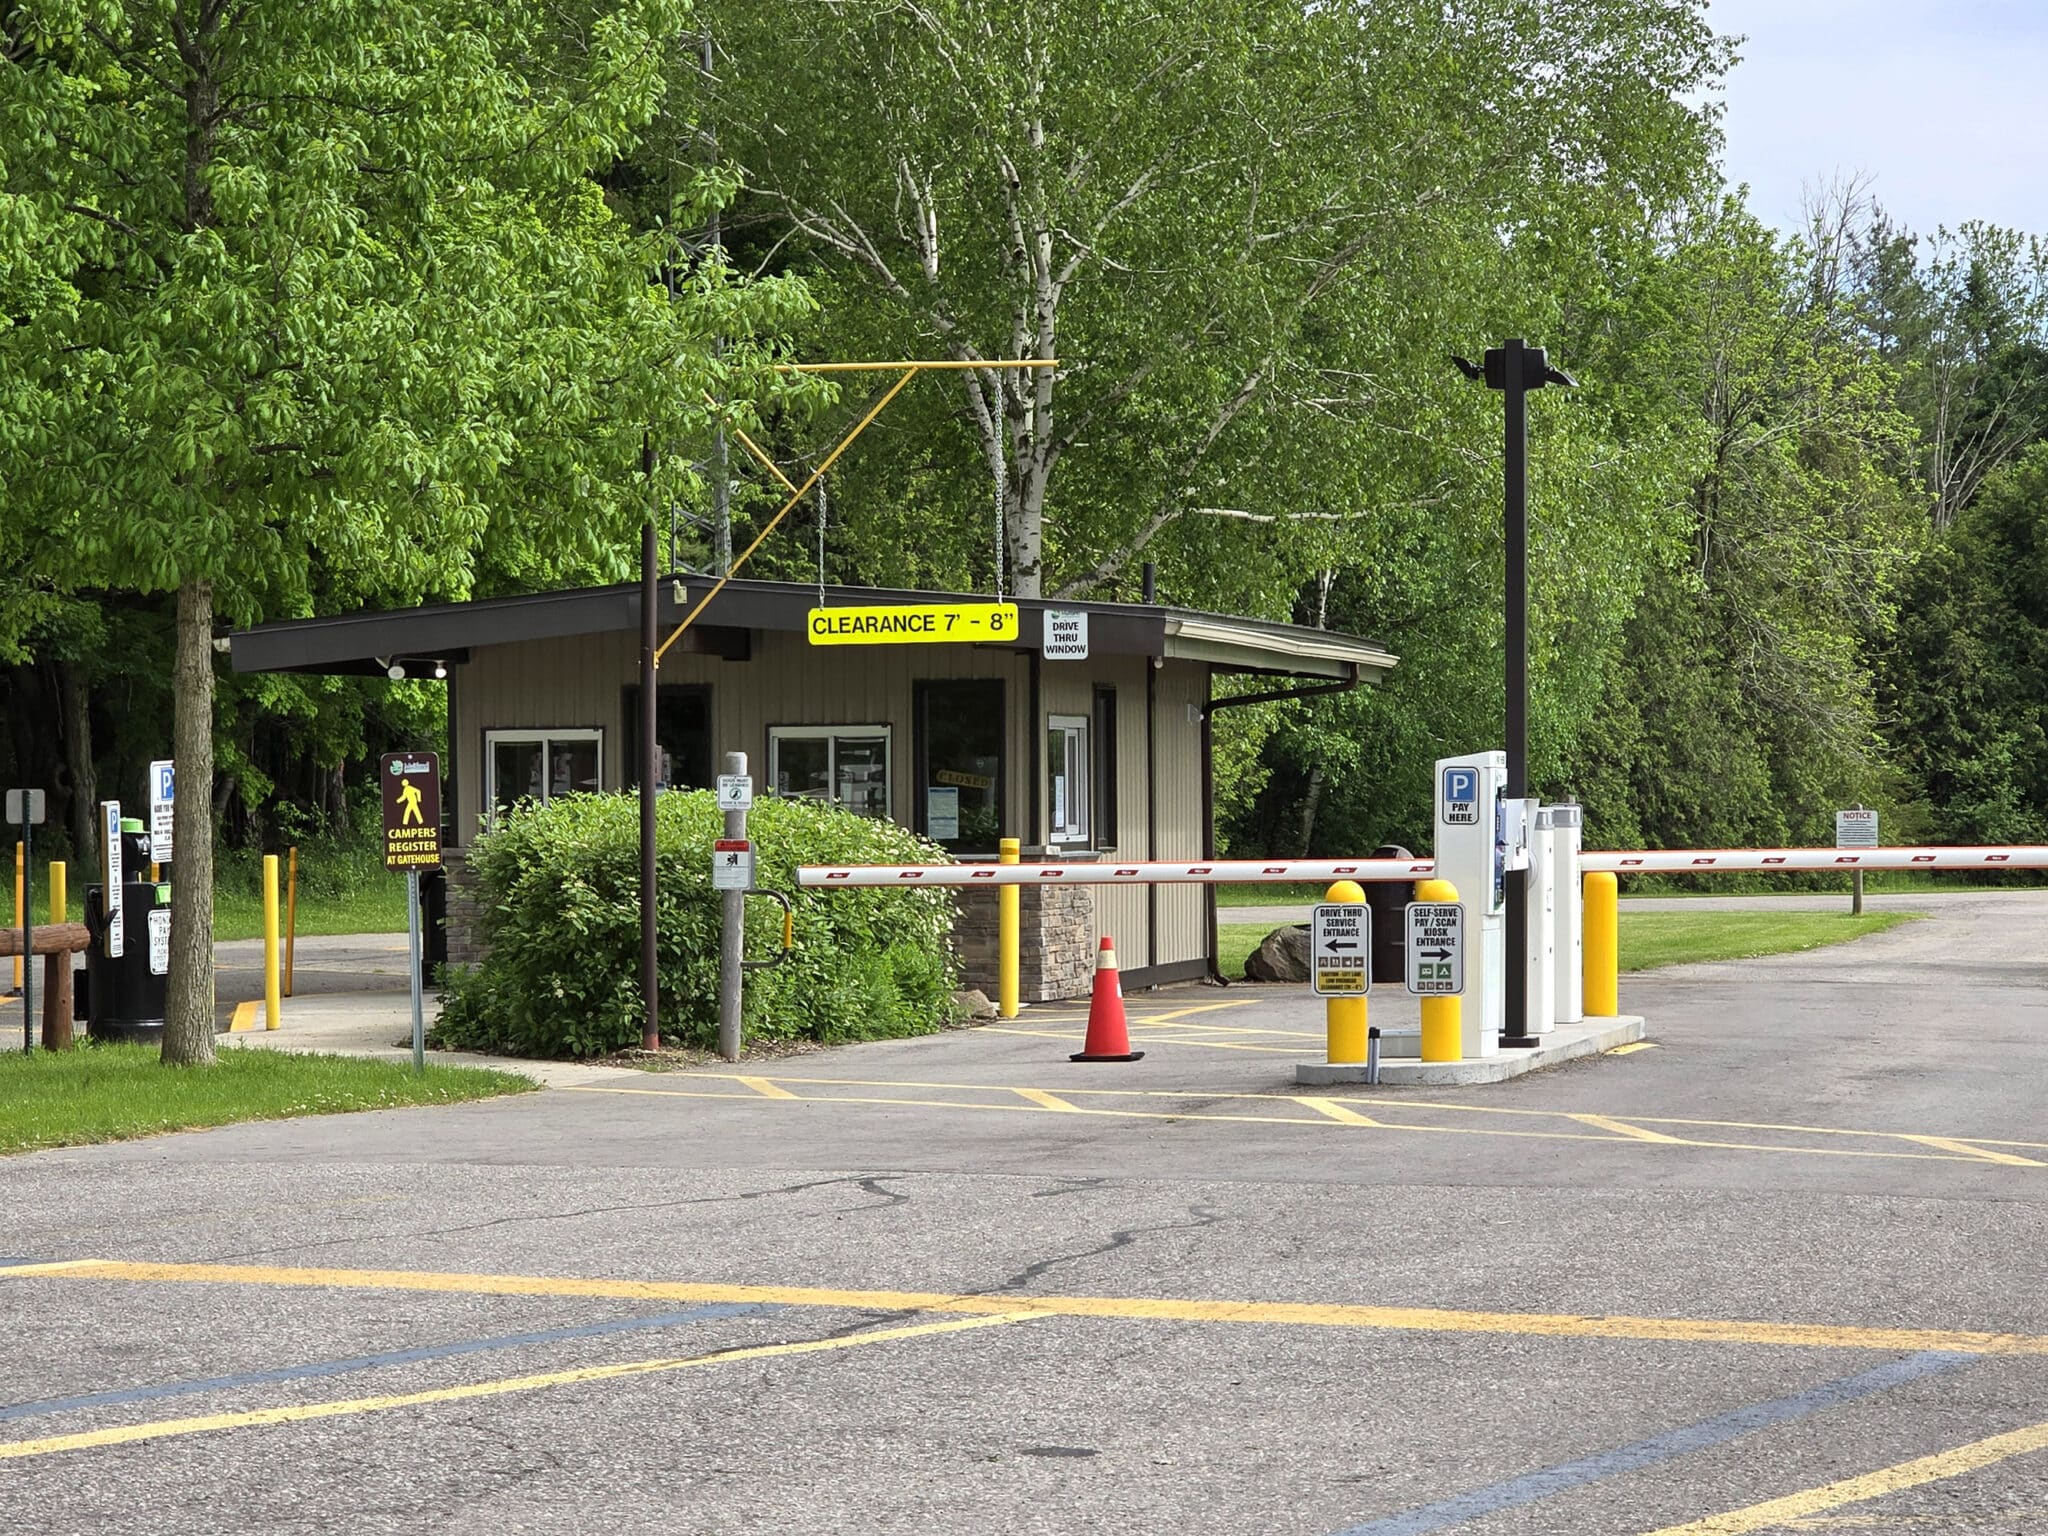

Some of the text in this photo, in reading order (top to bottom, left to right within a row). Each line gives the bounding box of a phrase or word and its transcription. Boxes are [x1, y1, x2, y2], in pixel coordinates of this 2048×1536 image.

[812, 614, 936, 634] CLEARANCE
[943, 614, 961, 632] 7'
[990, 613, 1014, 631] 8"
[1052, 622, 1079, 631] DRIVE
[1053, 633, 1078, 642] THRU
[1046, 645, 1086, 654] WINDOW
[939, 771, 988, 787] CLOSED
[1452, 774, 1469, 798] P
[1452, 803, 1470, 812] PAY
[1449, 813, 1472, 822] HERE
[1843, 812, 1872, 820] NOTICE
[388, 827, 437, 839] CAMPERS
[388, 841, 437, 852] REGISTER
[387, 854, 440, 865] AT GATEHOUSE
[1320, 908, 1362, 917] DRIVE THRU
[1414, 908, 1458, 917] SELF-SERVE
[1326, 918, 1356, 927] SERVICE
[1414, 918, 1429, 927] PAY
[1435, 918, 1457, 927] SCAN
[1323, 928, 1360, 937] ENTRANCE
[1423, 928, 1448, 937] KIOSK
[1416, 937, 1456, 947] ENTRANCE
